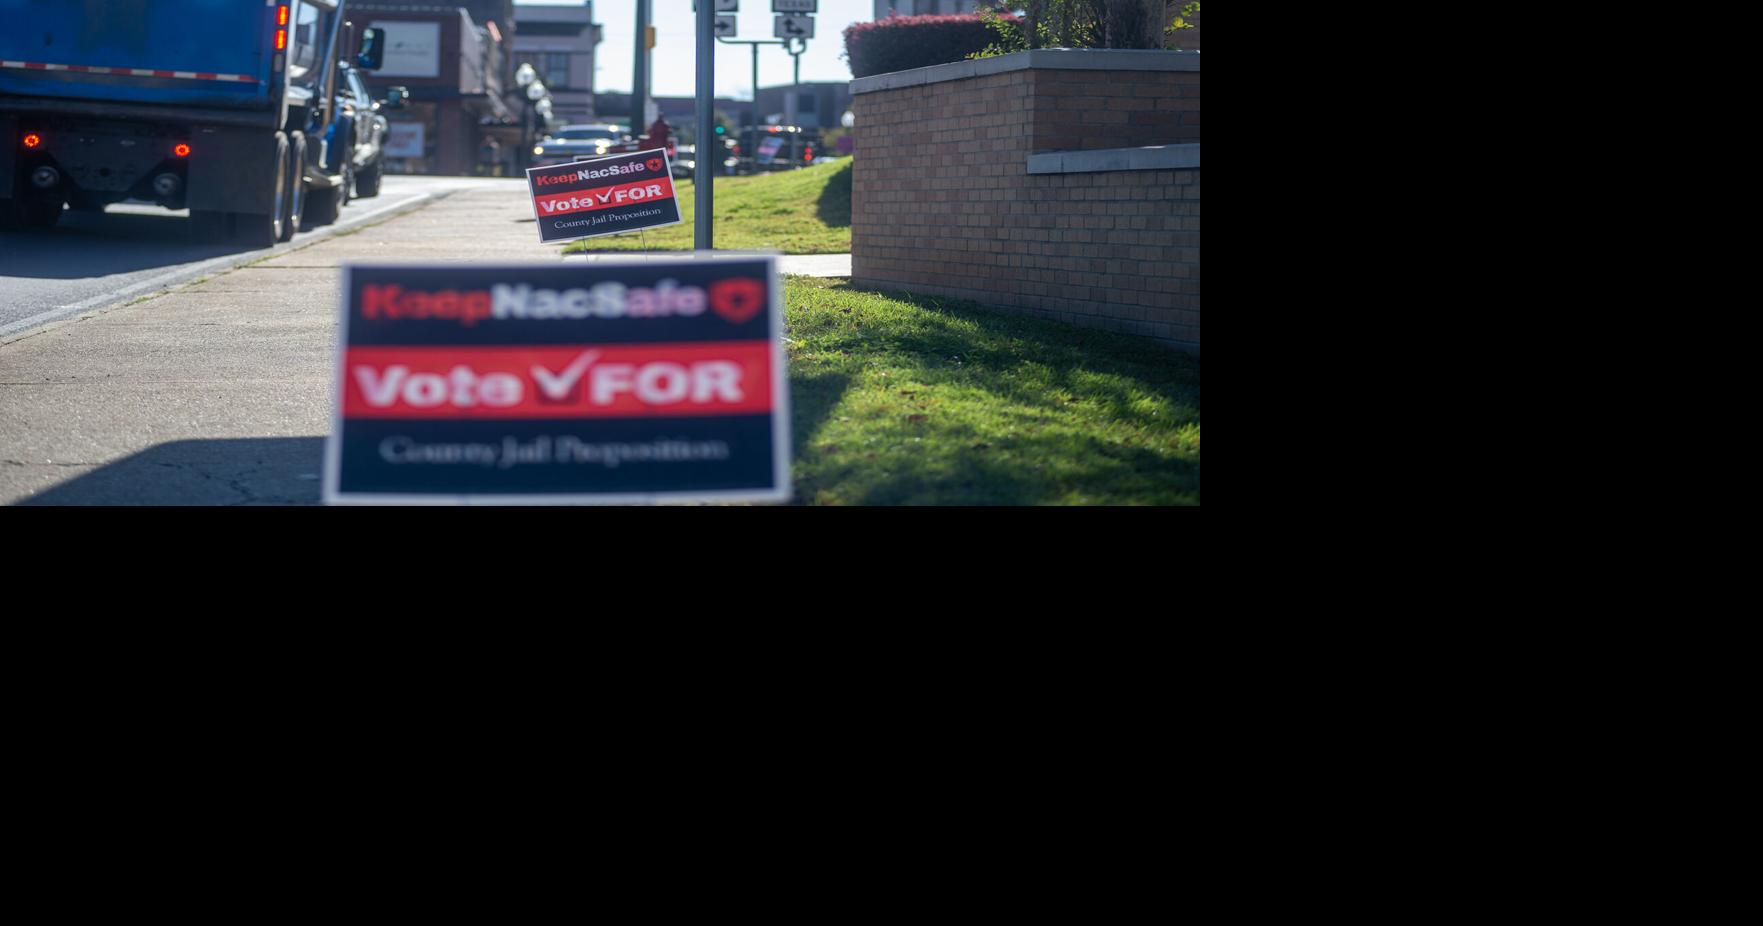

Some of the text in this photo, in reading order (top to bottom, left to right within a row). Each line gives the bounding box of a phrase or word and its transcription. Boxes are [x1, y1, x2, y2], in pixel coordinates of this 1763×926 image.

[537, 162, 645, 186] KeepNacSafe
[540, 184, 663, 212] Vote FOR
[554, 208, 661, 229] County Jail Proposition
[362, 279, 708, 324] KeepNacSafe
[355, 360, 745, 408] Vote FOR
[379, 435, 728, 467] County Jail Proposition
